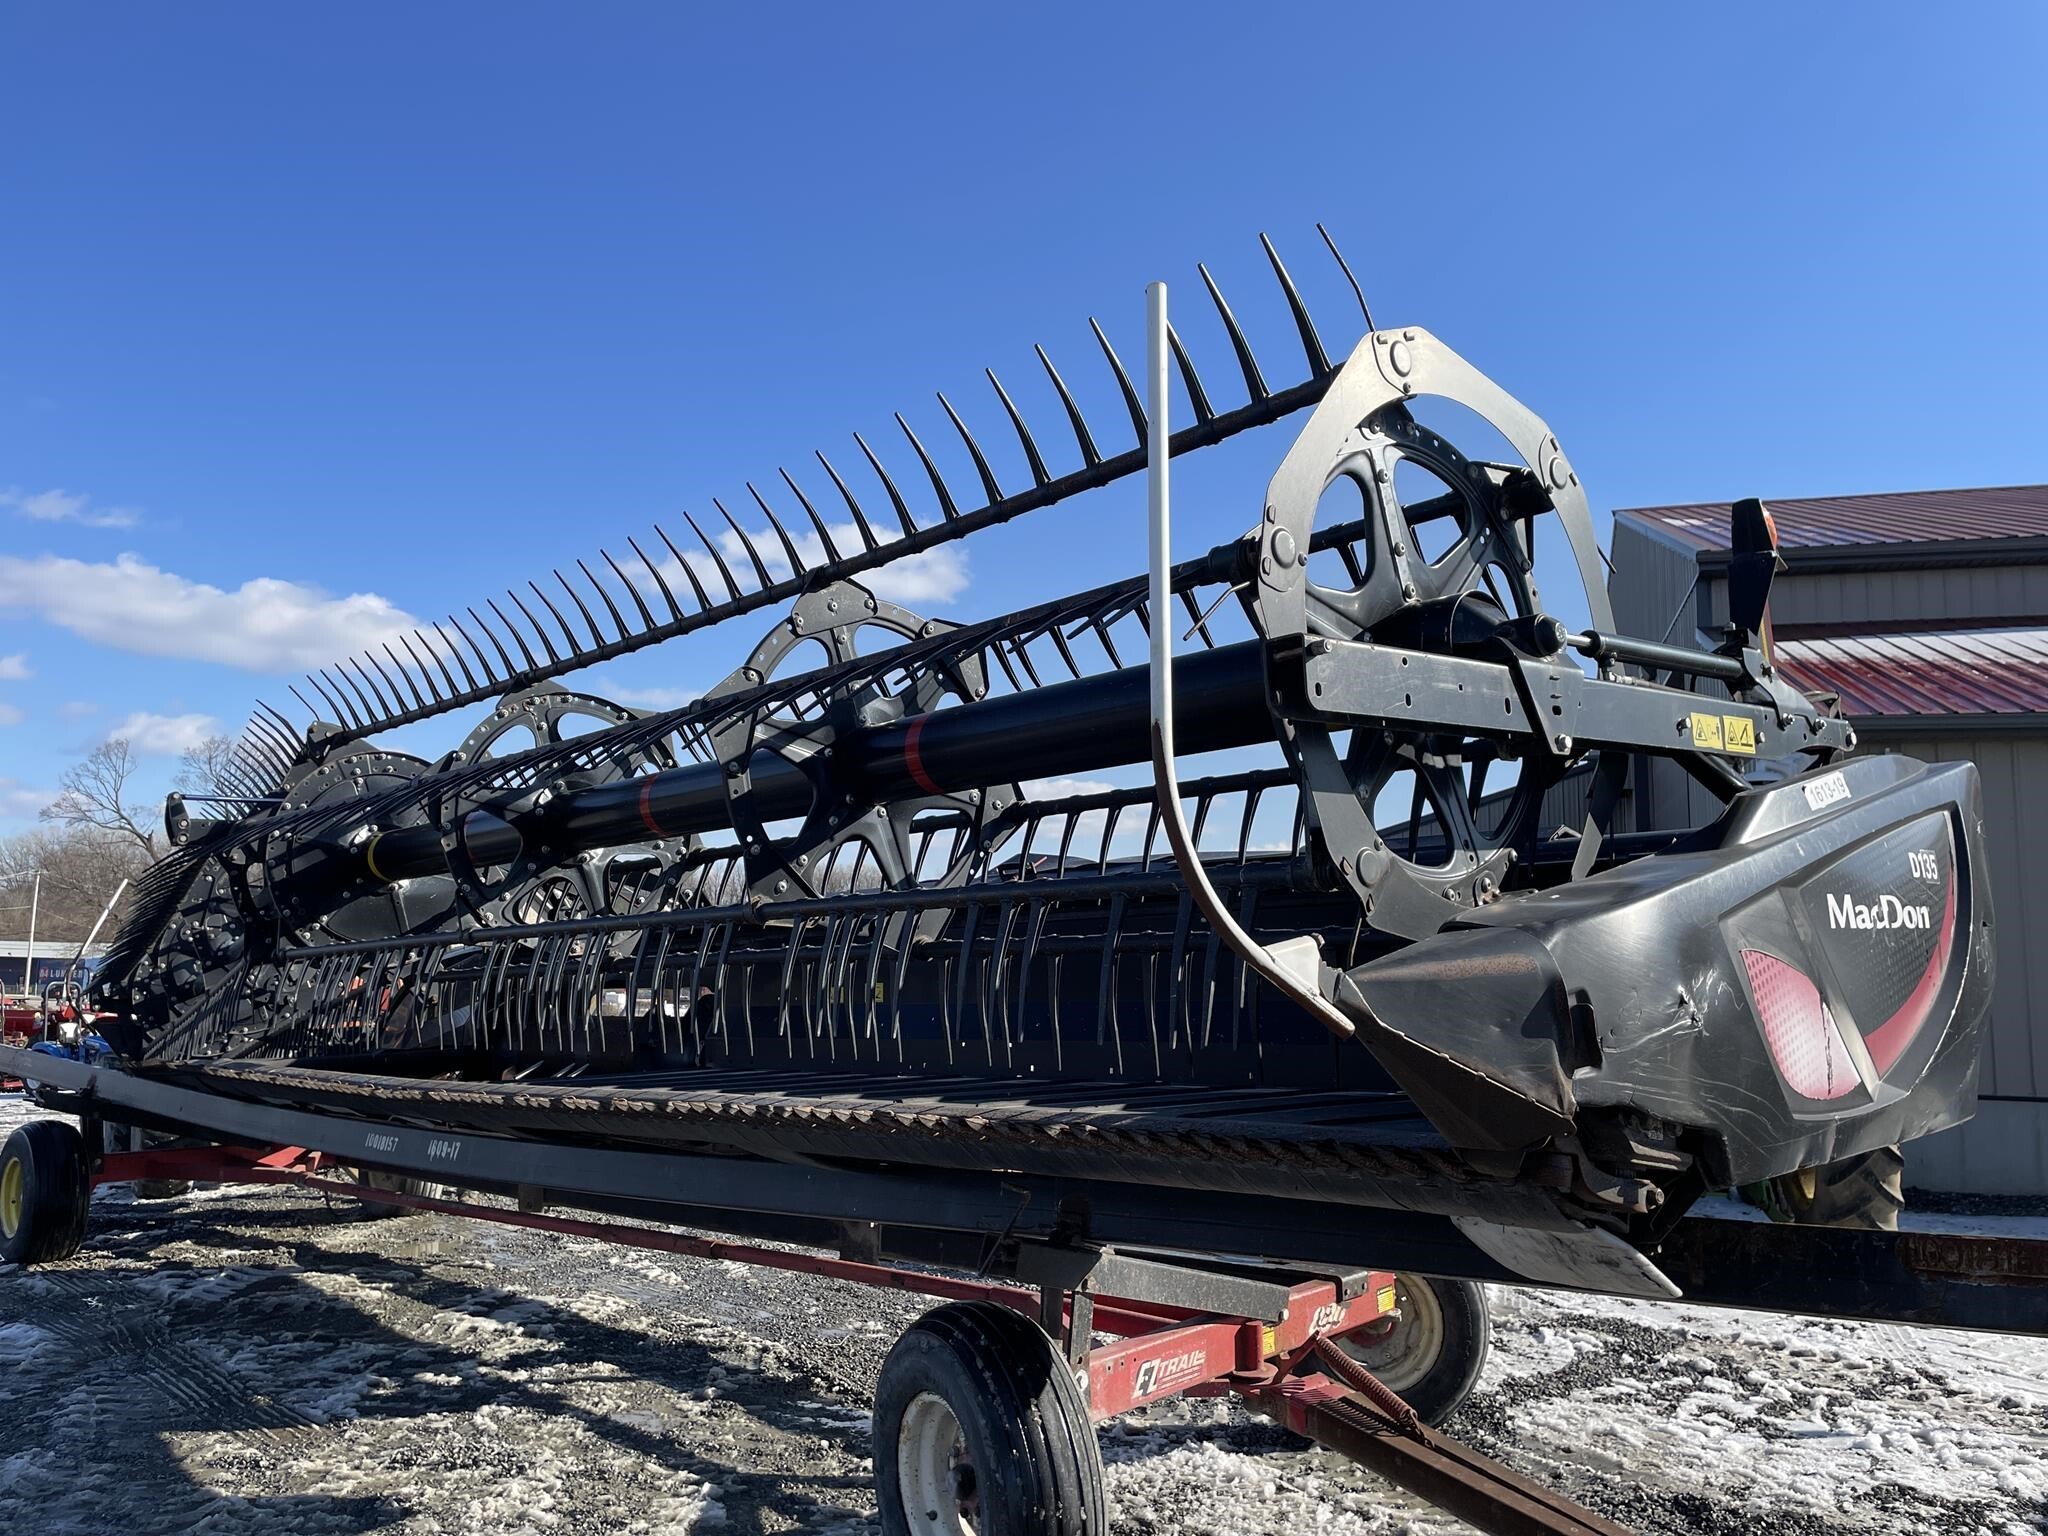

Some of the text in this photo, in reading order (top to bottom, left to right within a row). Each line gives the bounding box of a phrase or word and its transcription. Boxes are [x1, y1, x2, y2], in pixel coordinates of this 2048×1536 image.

[1811, 776, 1845, 803] 1613-19
[1908, 851, 1938, 880] D135
[1827, 893, 1931, 929] MacDon
